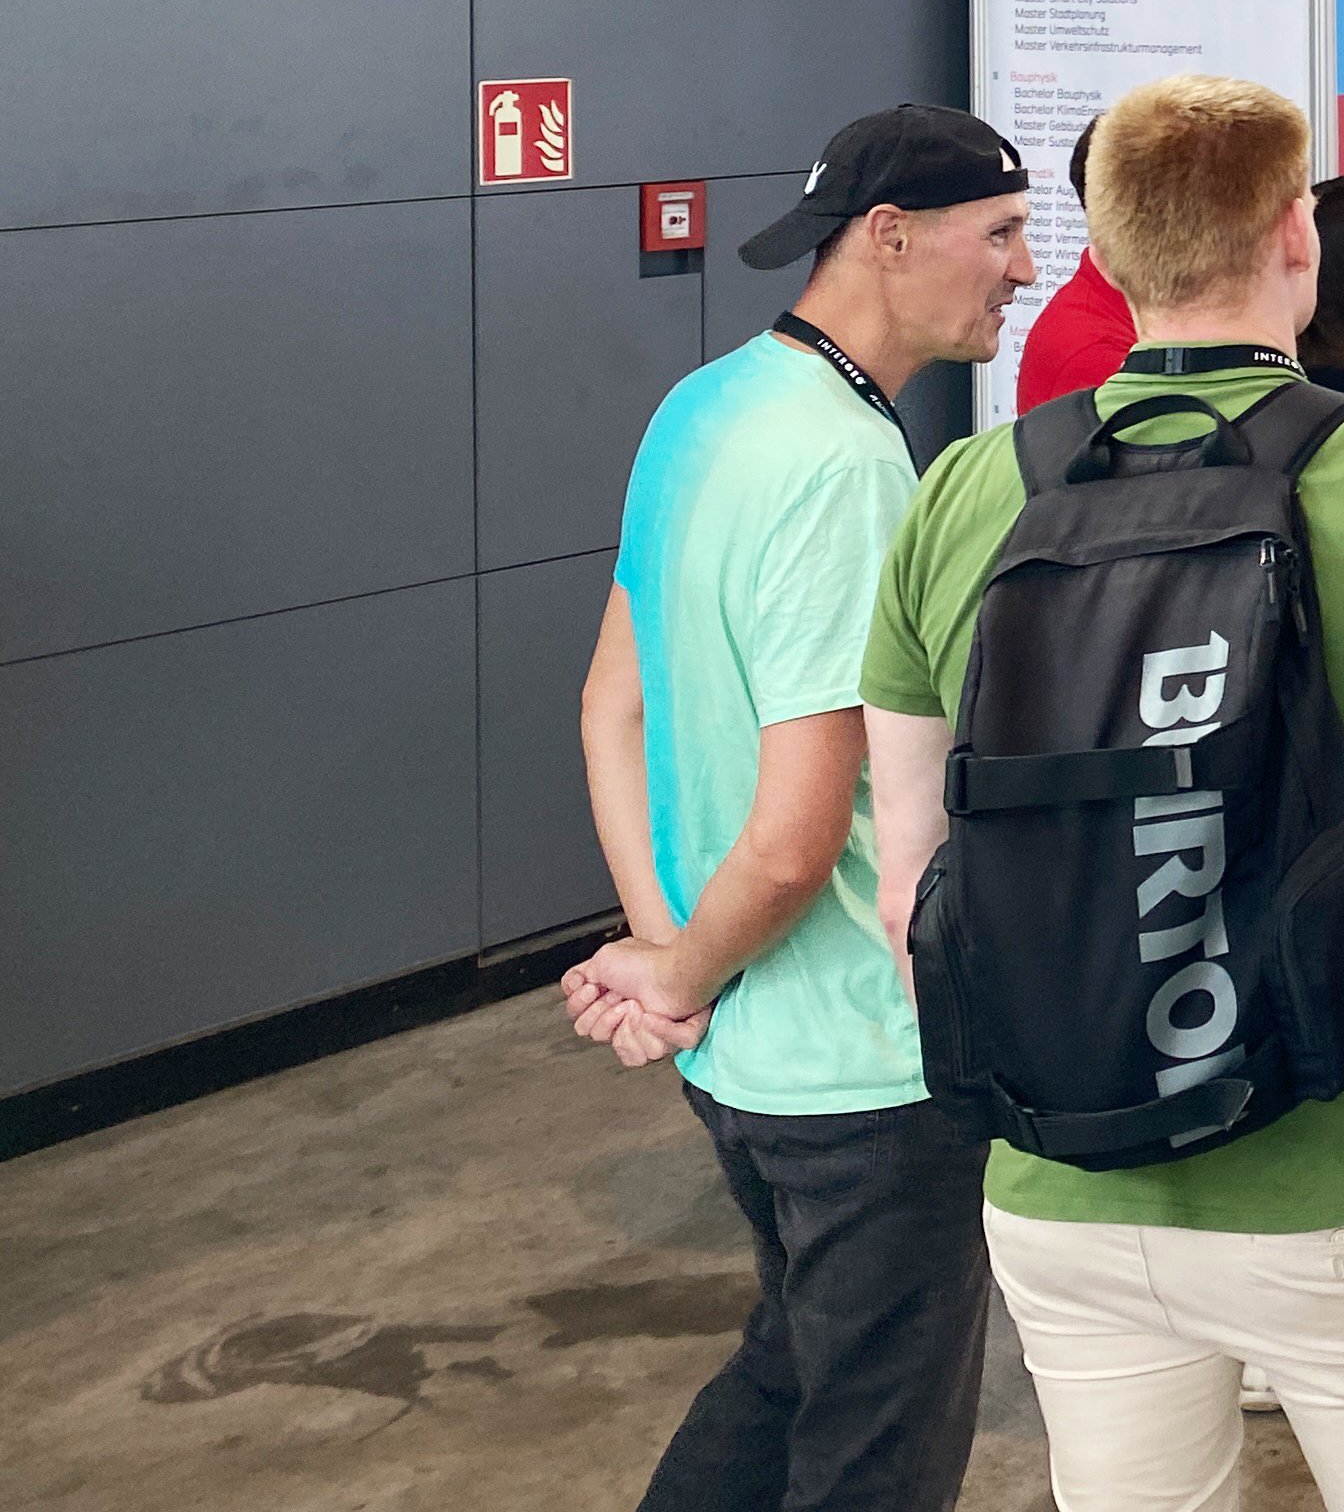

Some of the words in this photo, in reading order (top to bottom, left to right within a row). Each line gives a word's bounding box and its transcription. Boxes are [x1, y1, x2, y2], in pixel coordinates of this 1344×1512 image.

[1015, 7, 1045, 19] Master
[1015, 23, 1045, 35] Master
[1015, 40, 1045, 51] Master
[1014, 87, 1055, 99] Bachelor
[1014, 103, 1055, 115] Bachelor
[1014, 119, 1047, 131] Master
[1014, 135, 1046, 147] Master
